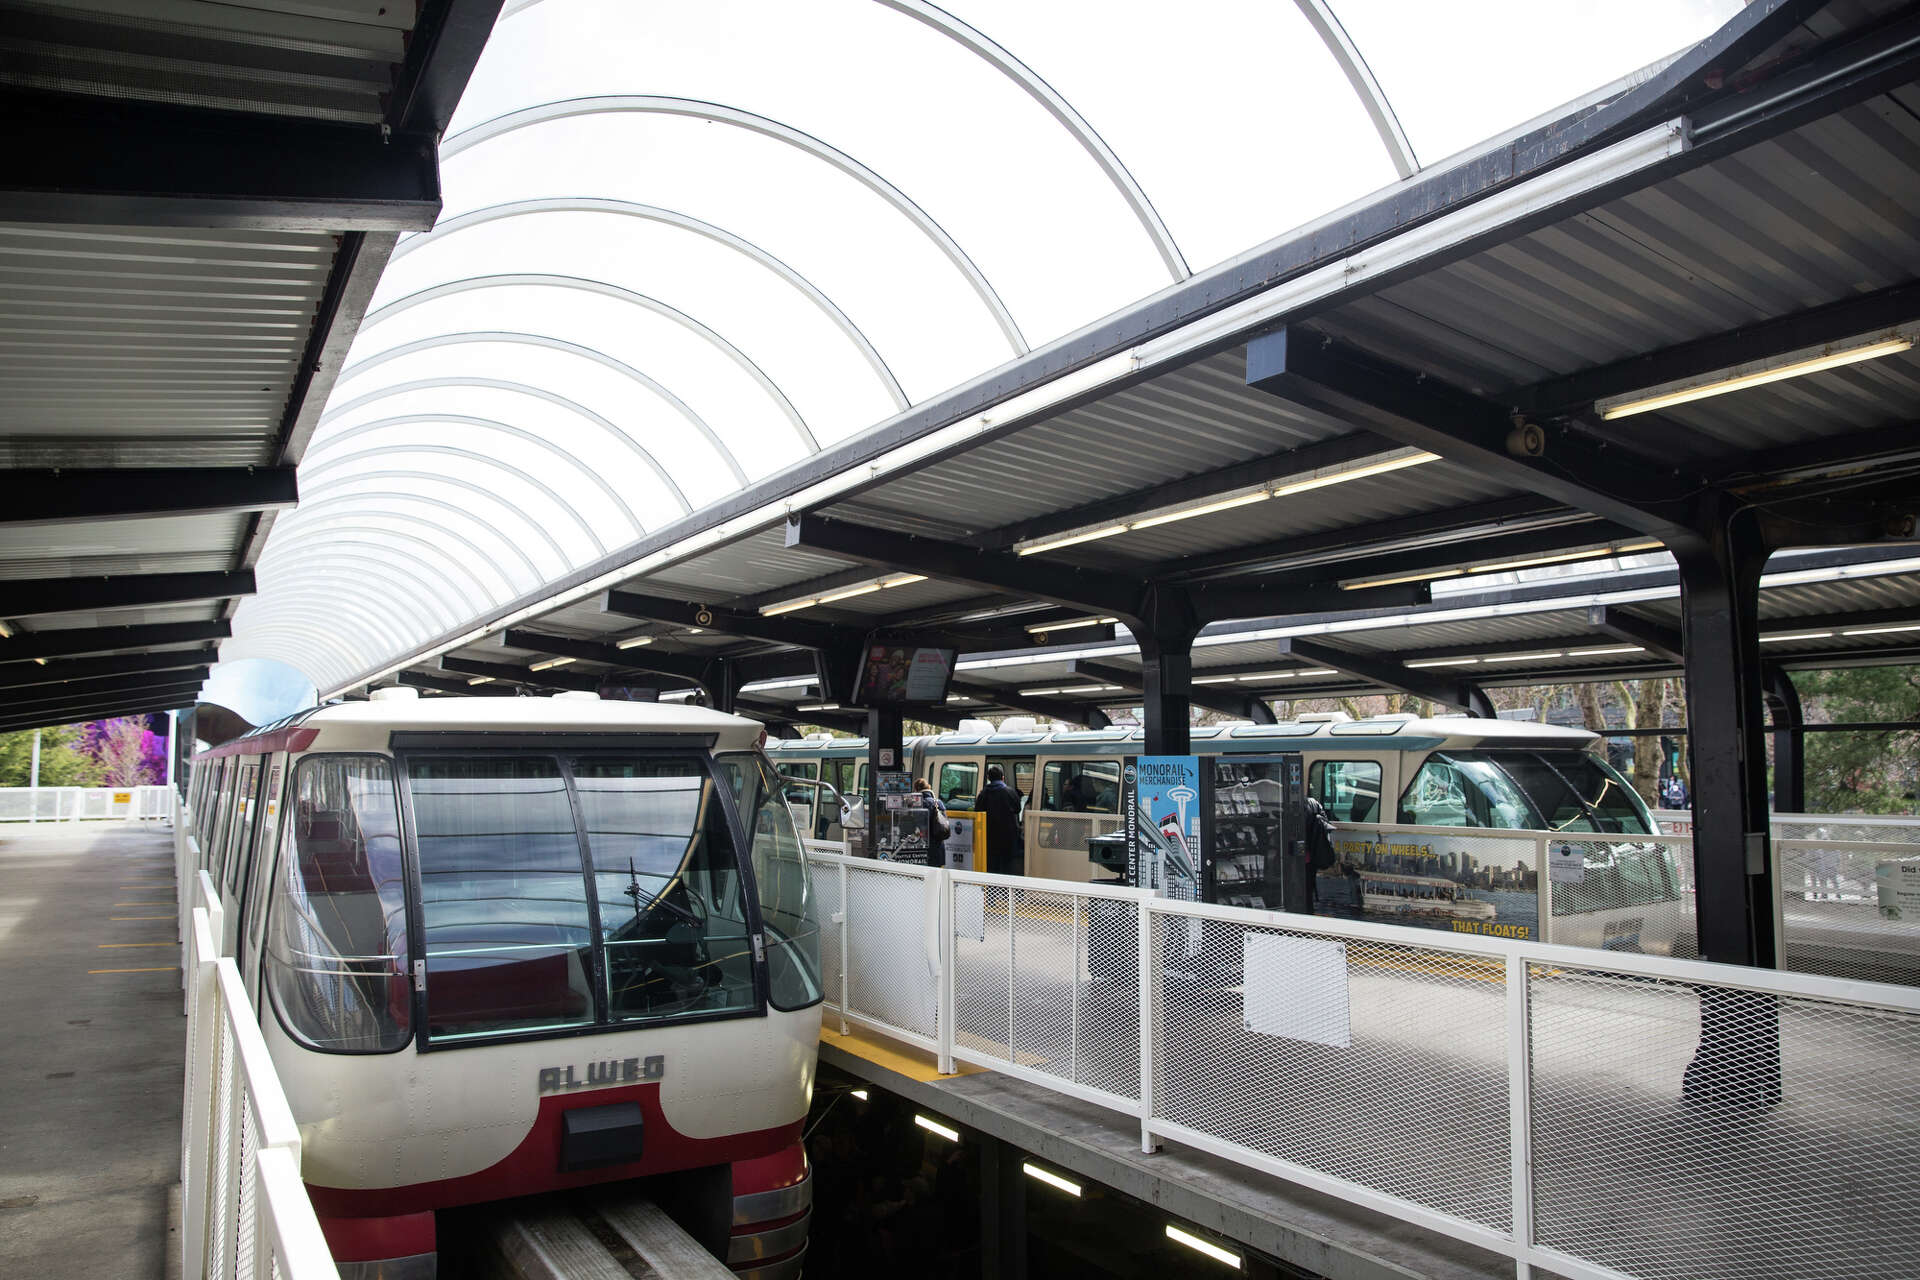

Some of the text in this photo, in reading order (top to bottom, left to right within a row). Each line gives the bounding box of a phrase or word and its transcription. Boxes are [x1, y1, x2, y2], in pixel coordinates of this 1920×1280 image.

[1139, 764, 1186, 776] MONORAIL
[1139, 776, 1186, 785] MERCHANDISE
[1127, 789, 1136, 840] MONORAIL
[1343, 841, 1372, 854] PARTY
[1375, 843, 1388, 854] ON
[1127, 840, 1136, 876] CENTER
[1451, 920, 1529, 940] THAT FLOATS!
[539, 1055, 664, 1093] ALWEG
